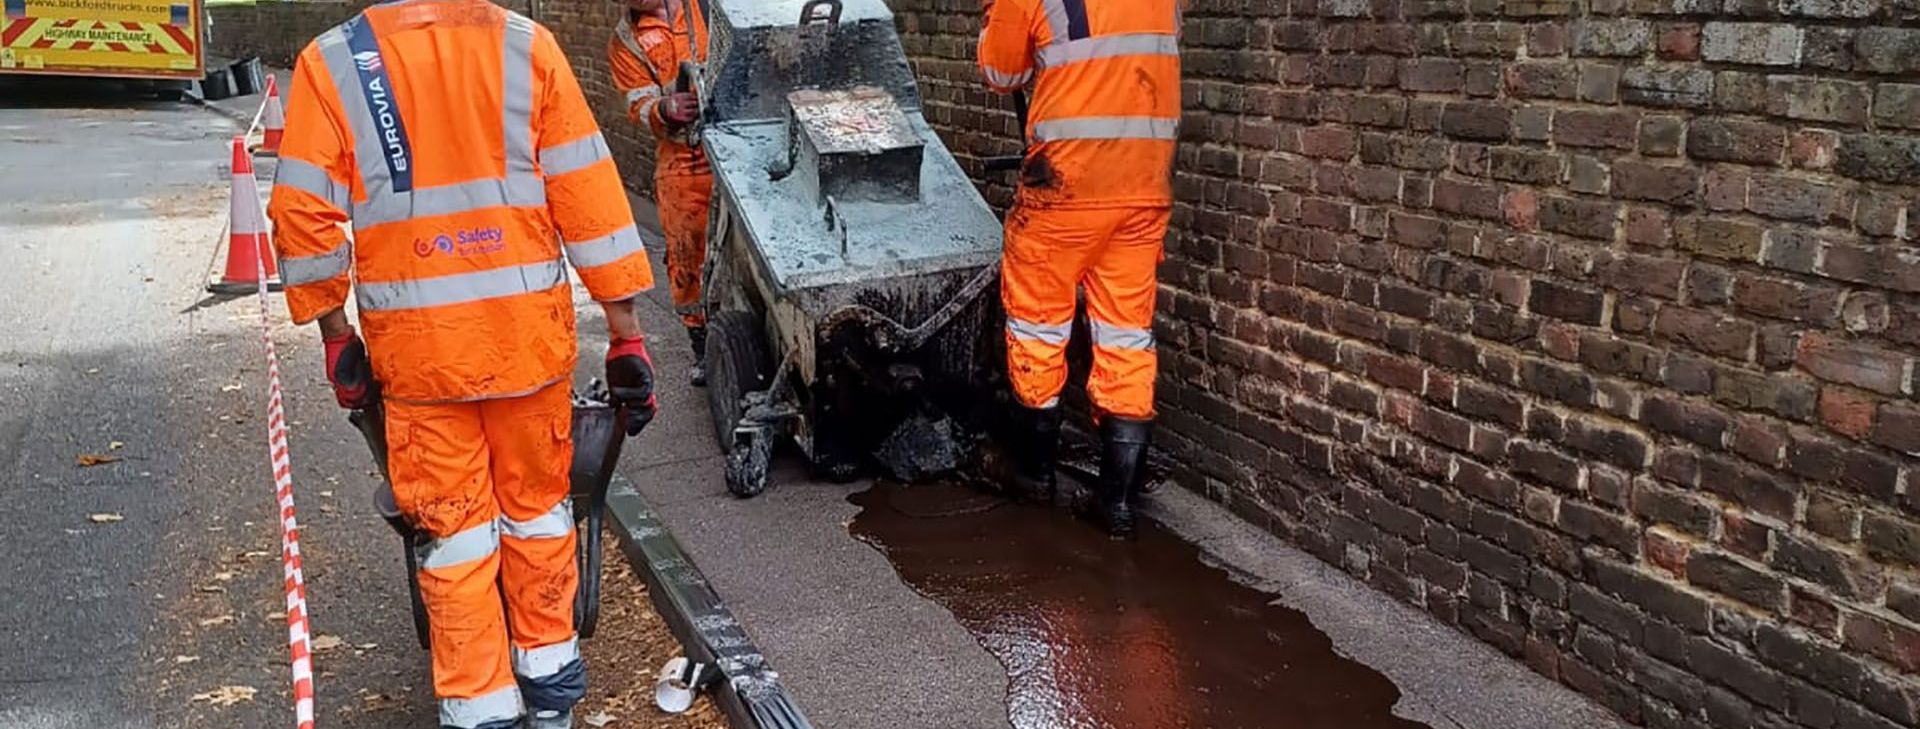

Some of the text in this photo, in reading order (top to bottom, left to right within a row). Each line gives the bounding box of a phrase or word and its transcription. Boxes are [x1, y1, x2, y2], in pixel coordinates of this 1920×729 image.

[45, 28, 153, 42] HIGHWAY MAINTENANCE
[369, 77, 407, 171] EUROVIA
[457, 227, 503, 244] Safety
